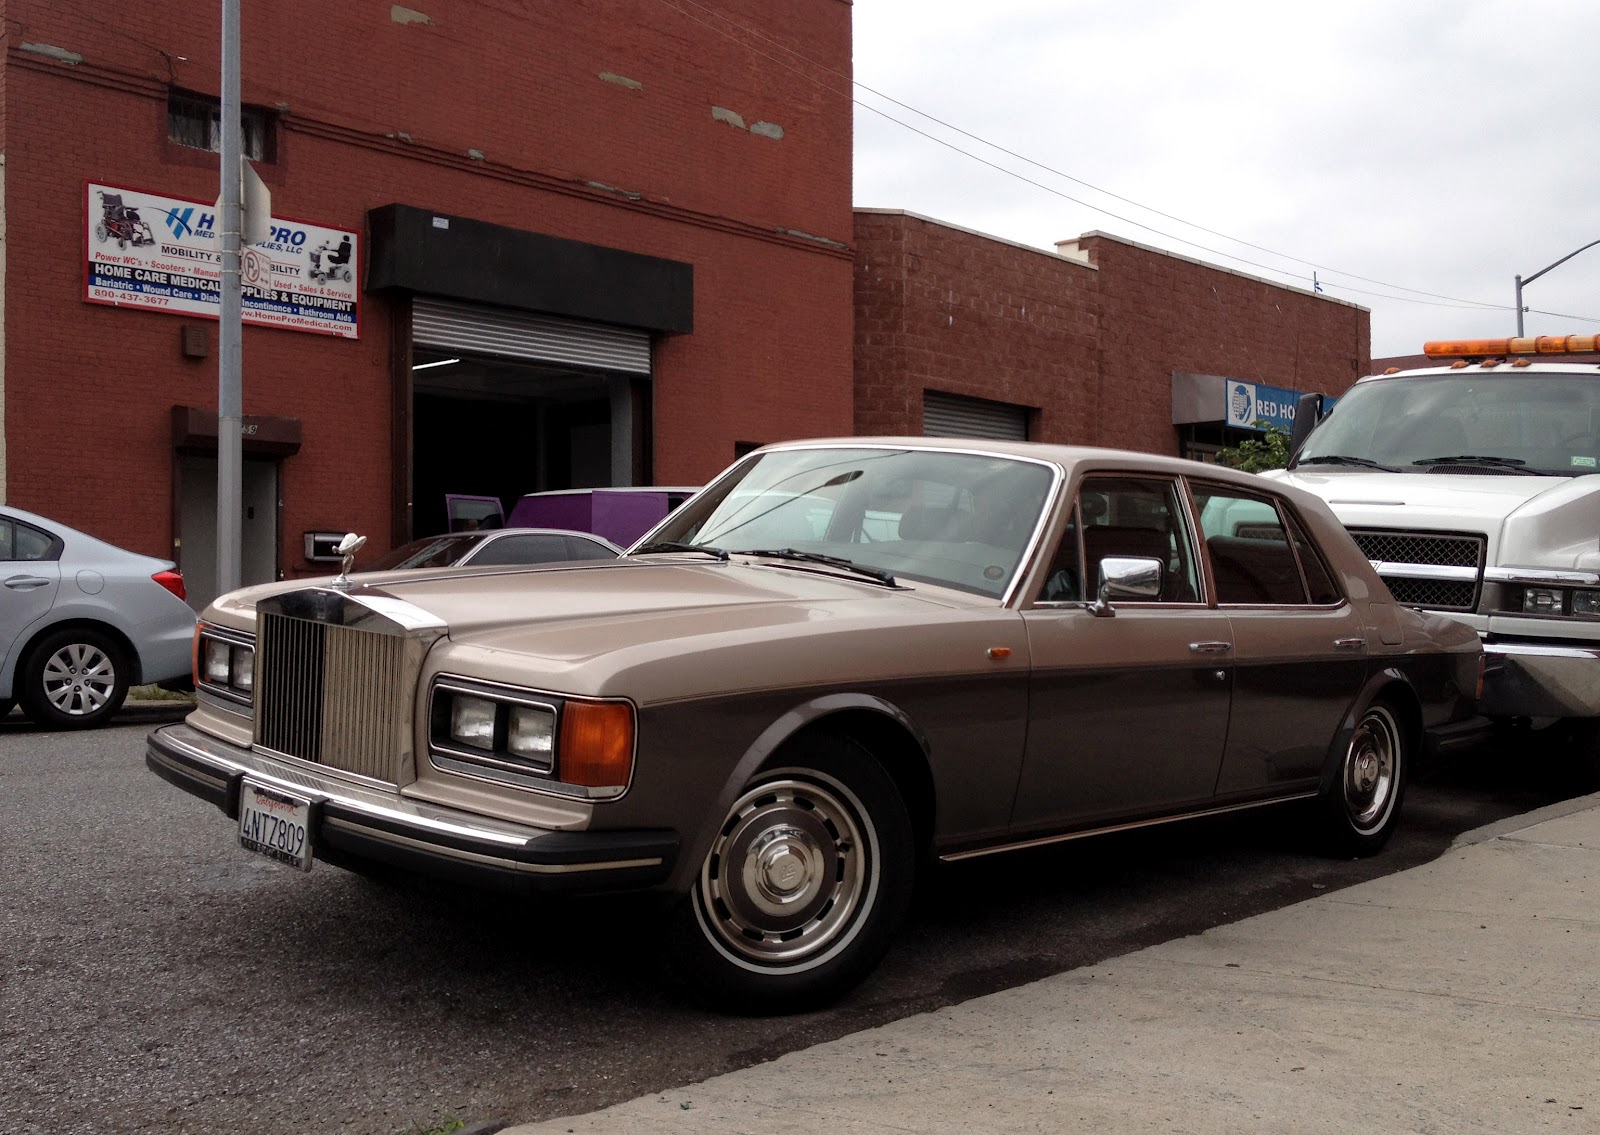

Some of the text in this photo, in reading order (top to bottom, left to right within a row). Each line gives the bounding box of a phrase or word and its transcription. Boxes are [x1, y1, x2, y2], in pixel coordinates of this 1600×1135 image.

[161, 246, 212, 261] MOBILITY
[270, 264, 301, 276] BILITY
[285, 246, 303, 255] LLC
[95, 251, 120, 263] Power
[123, 255, 142, 267] WC's
[151, 260, 186, 273] Scooters
[273, 279, 292, 290] Used
[298, 284, 317, 294] Sales
[320, 287, 325, 295] &
[327, 289, 352, 300] Service
[95, 263, 353, 312] HOME CARE MEDICAL PPLIES & EQUIPMENT
[94, 289, 353, 332] 800-437-3677 w.HomeProMedical.com
[95, 277, 352, 323] Bariatric Wound Care Diab Incontinence Bathroom Aids
[1256, 400, 1296, 420] RED HO
[243, 807, 305, 856] 4NTZ809
